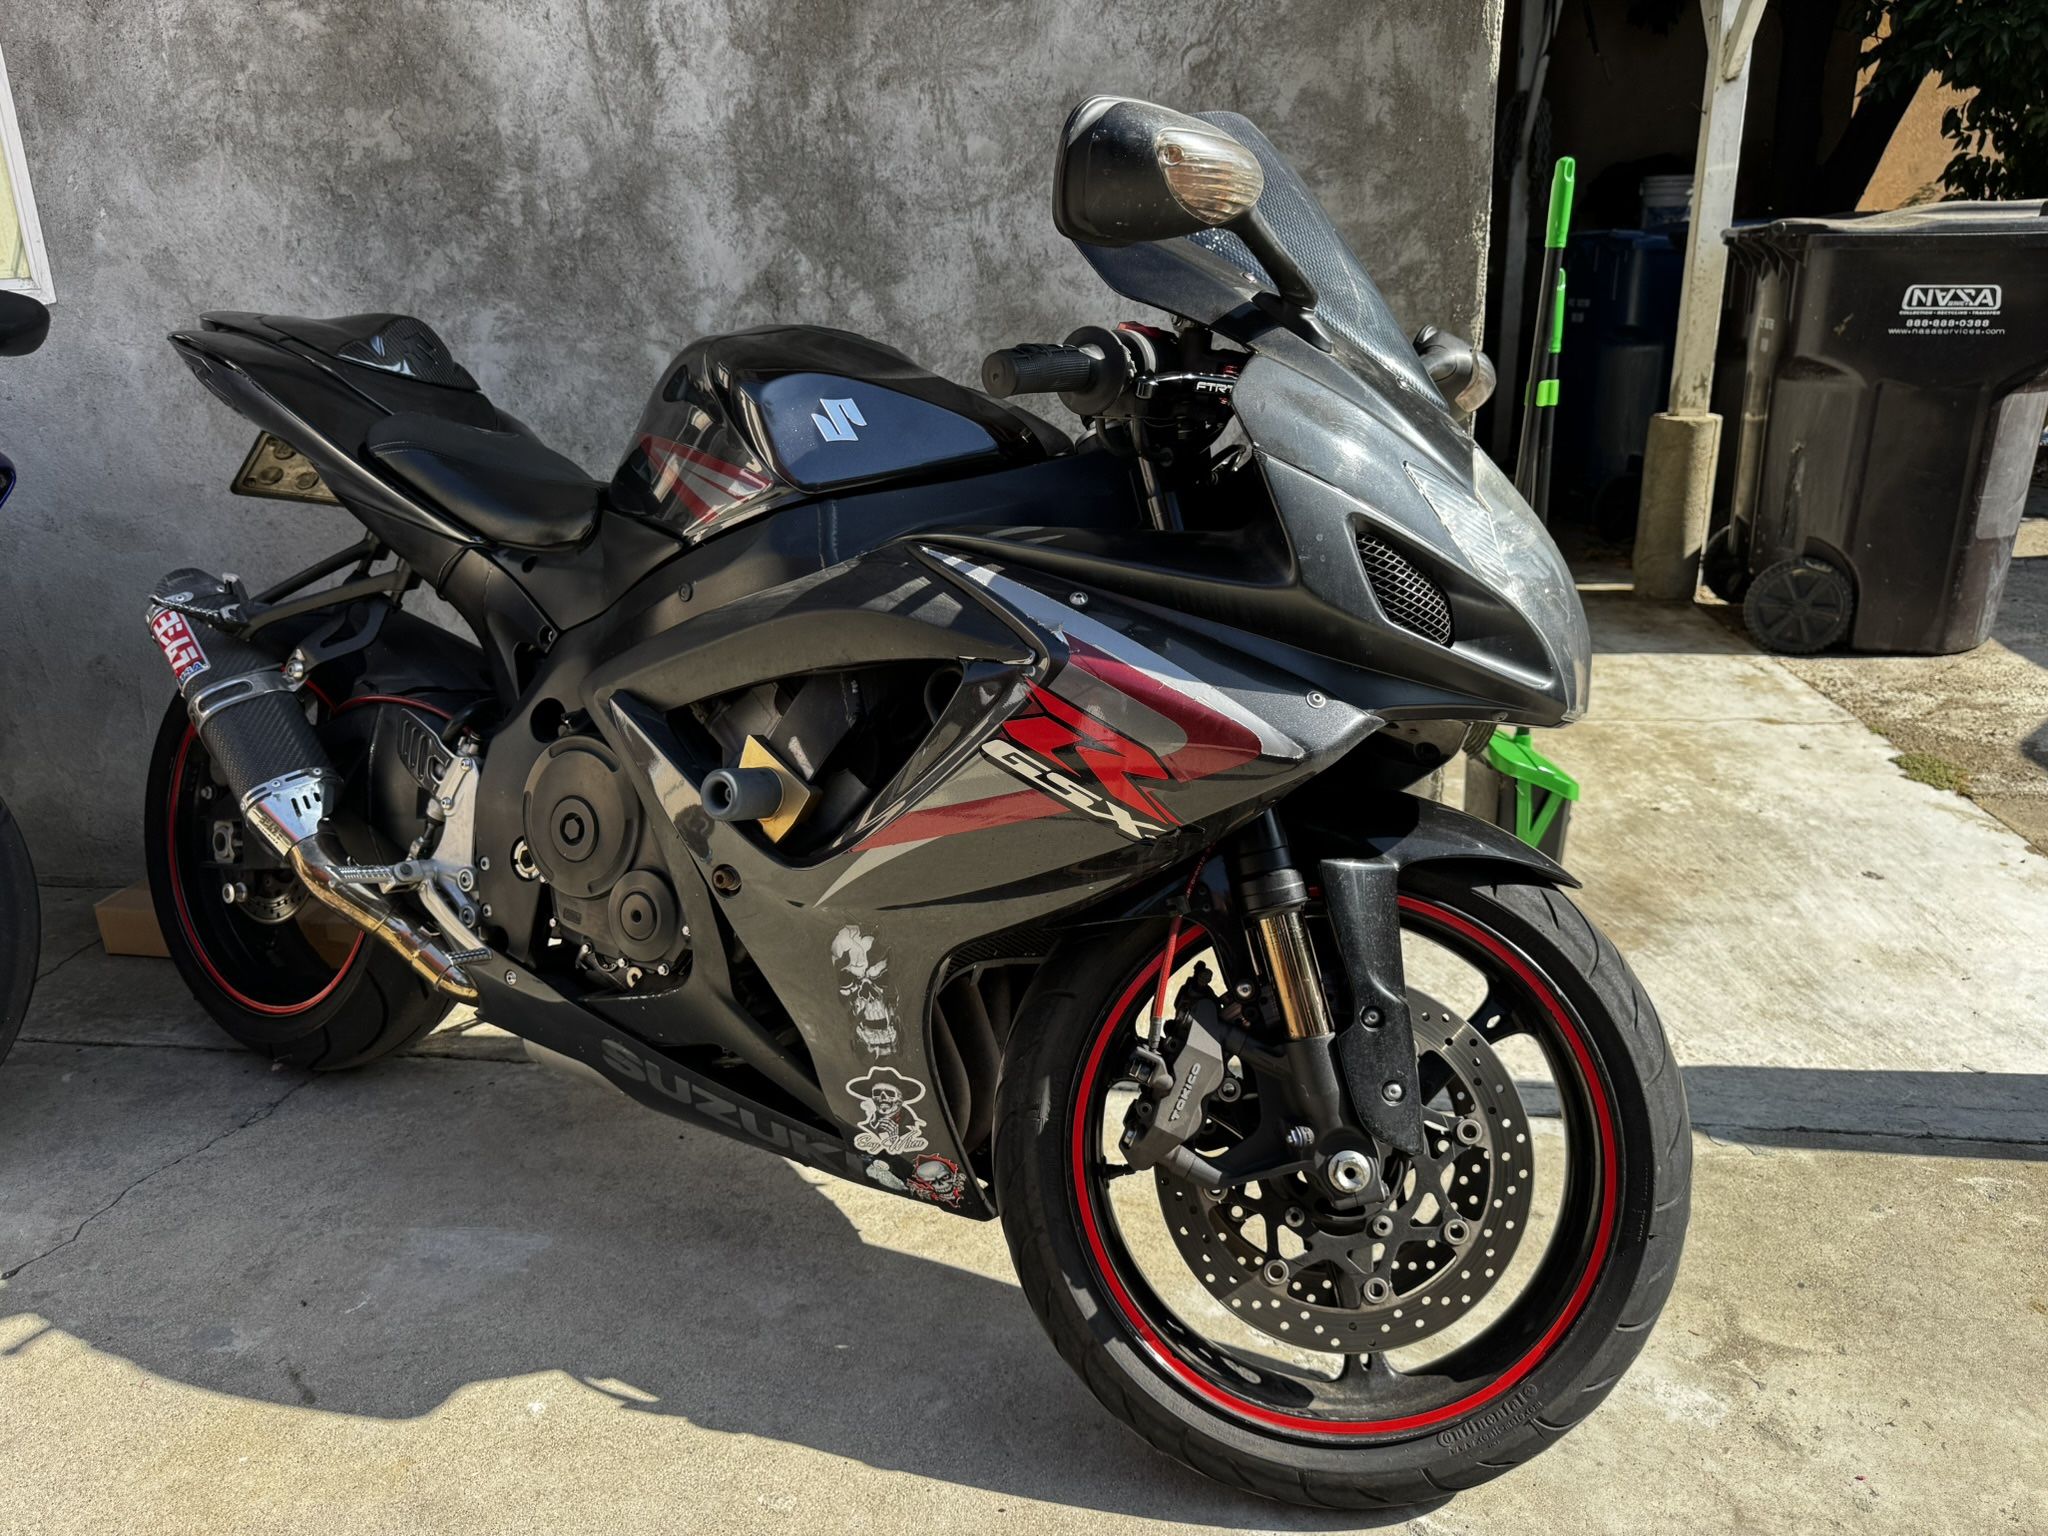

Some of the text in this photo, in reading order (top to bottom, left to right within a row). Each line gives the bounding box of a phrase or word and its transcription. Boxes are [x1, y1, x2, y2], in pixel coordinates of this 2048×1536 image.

[601, 1038, 864, 1181] SUZUKI
[1168, 1062, 1201, 1122] TOKICO
[856, 1130, 925, 1152] Say When
